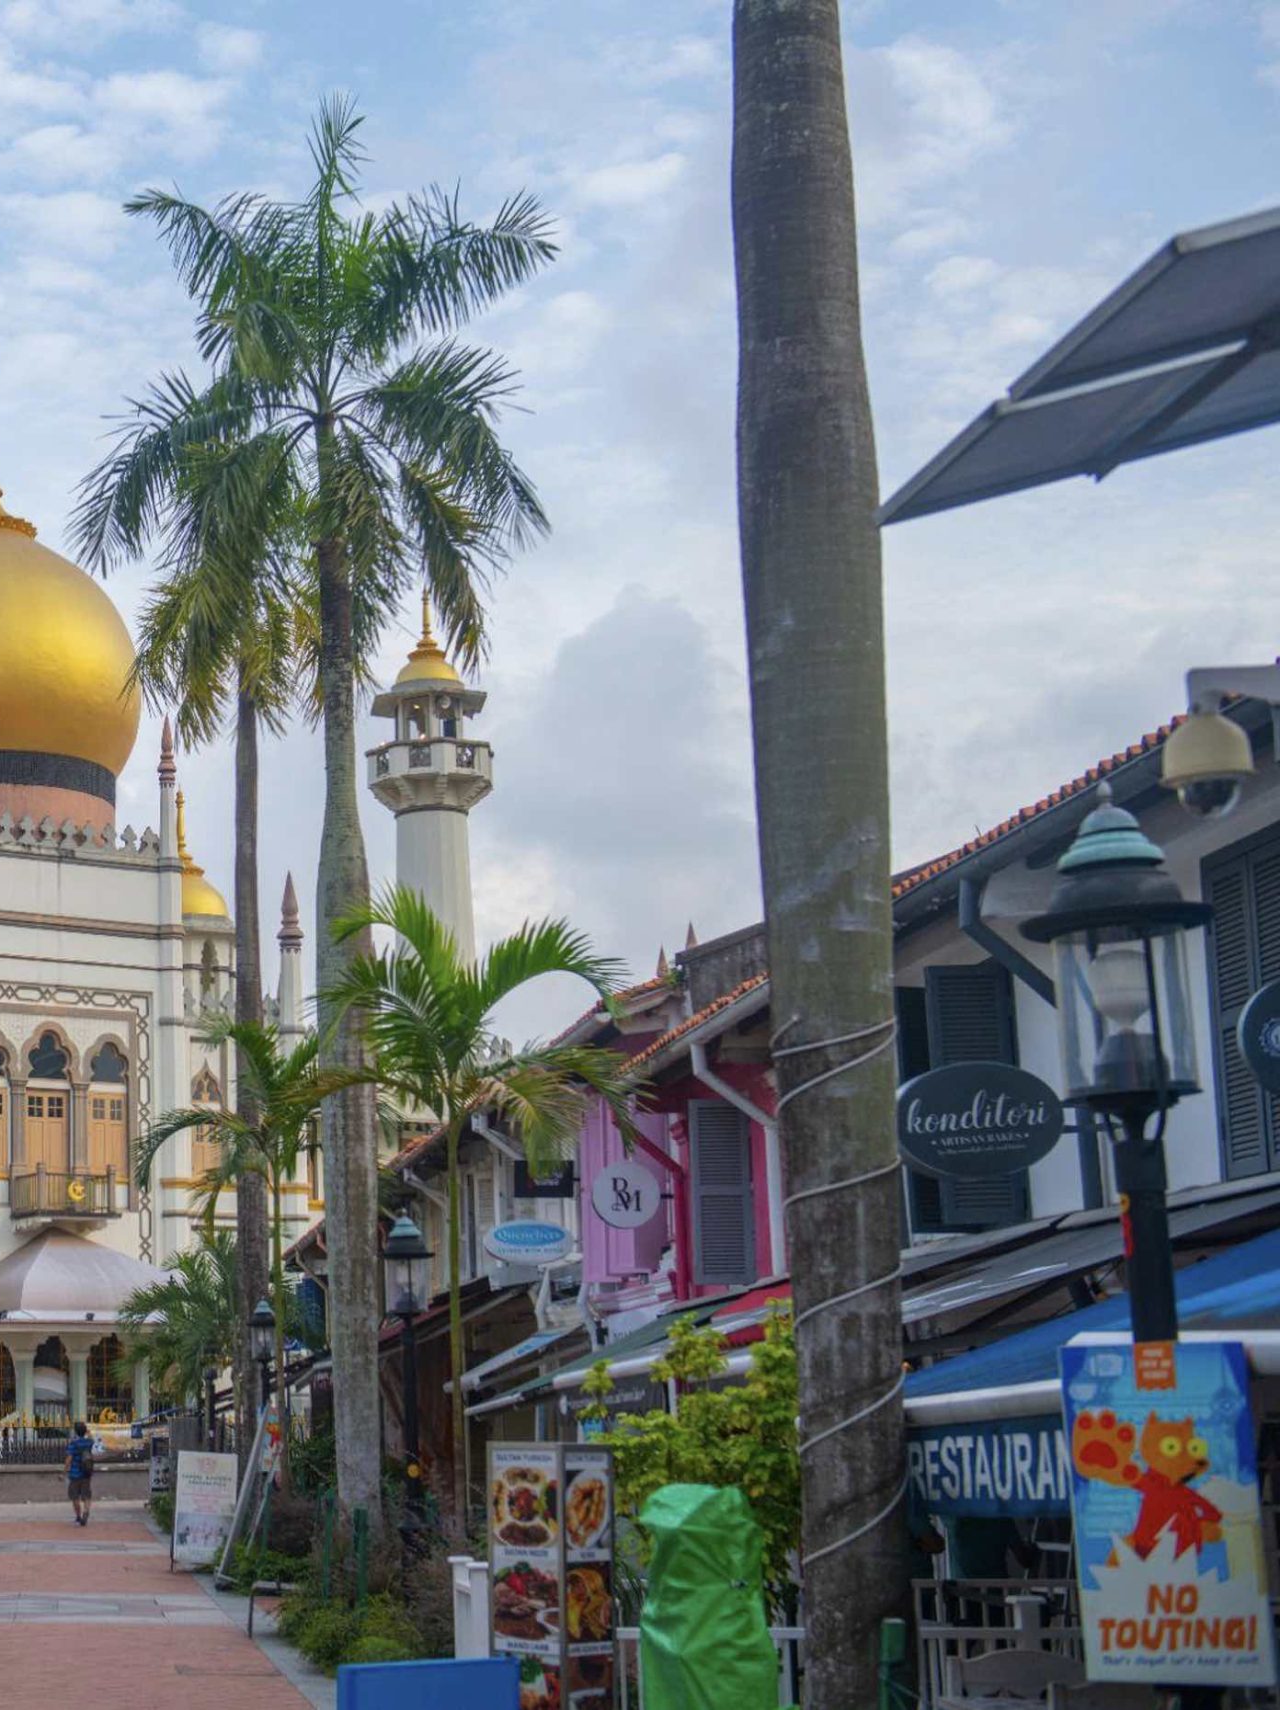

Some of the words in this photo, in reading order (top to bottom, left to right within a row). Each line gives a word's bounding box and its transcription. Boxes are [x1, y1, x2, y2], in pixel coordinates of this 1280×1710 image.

[907, 1088, 1047, 1134] konditori
[940, 1134, 985, 1147] ARTISAN
[987, 1132, 1021, 1144] BAKES
[907, 1429, 1072, 1500] RESTAURAN
[1147, 1583, 1199, 1615] NO
[1098, 1614, 1257, 1652] TOUTING!
